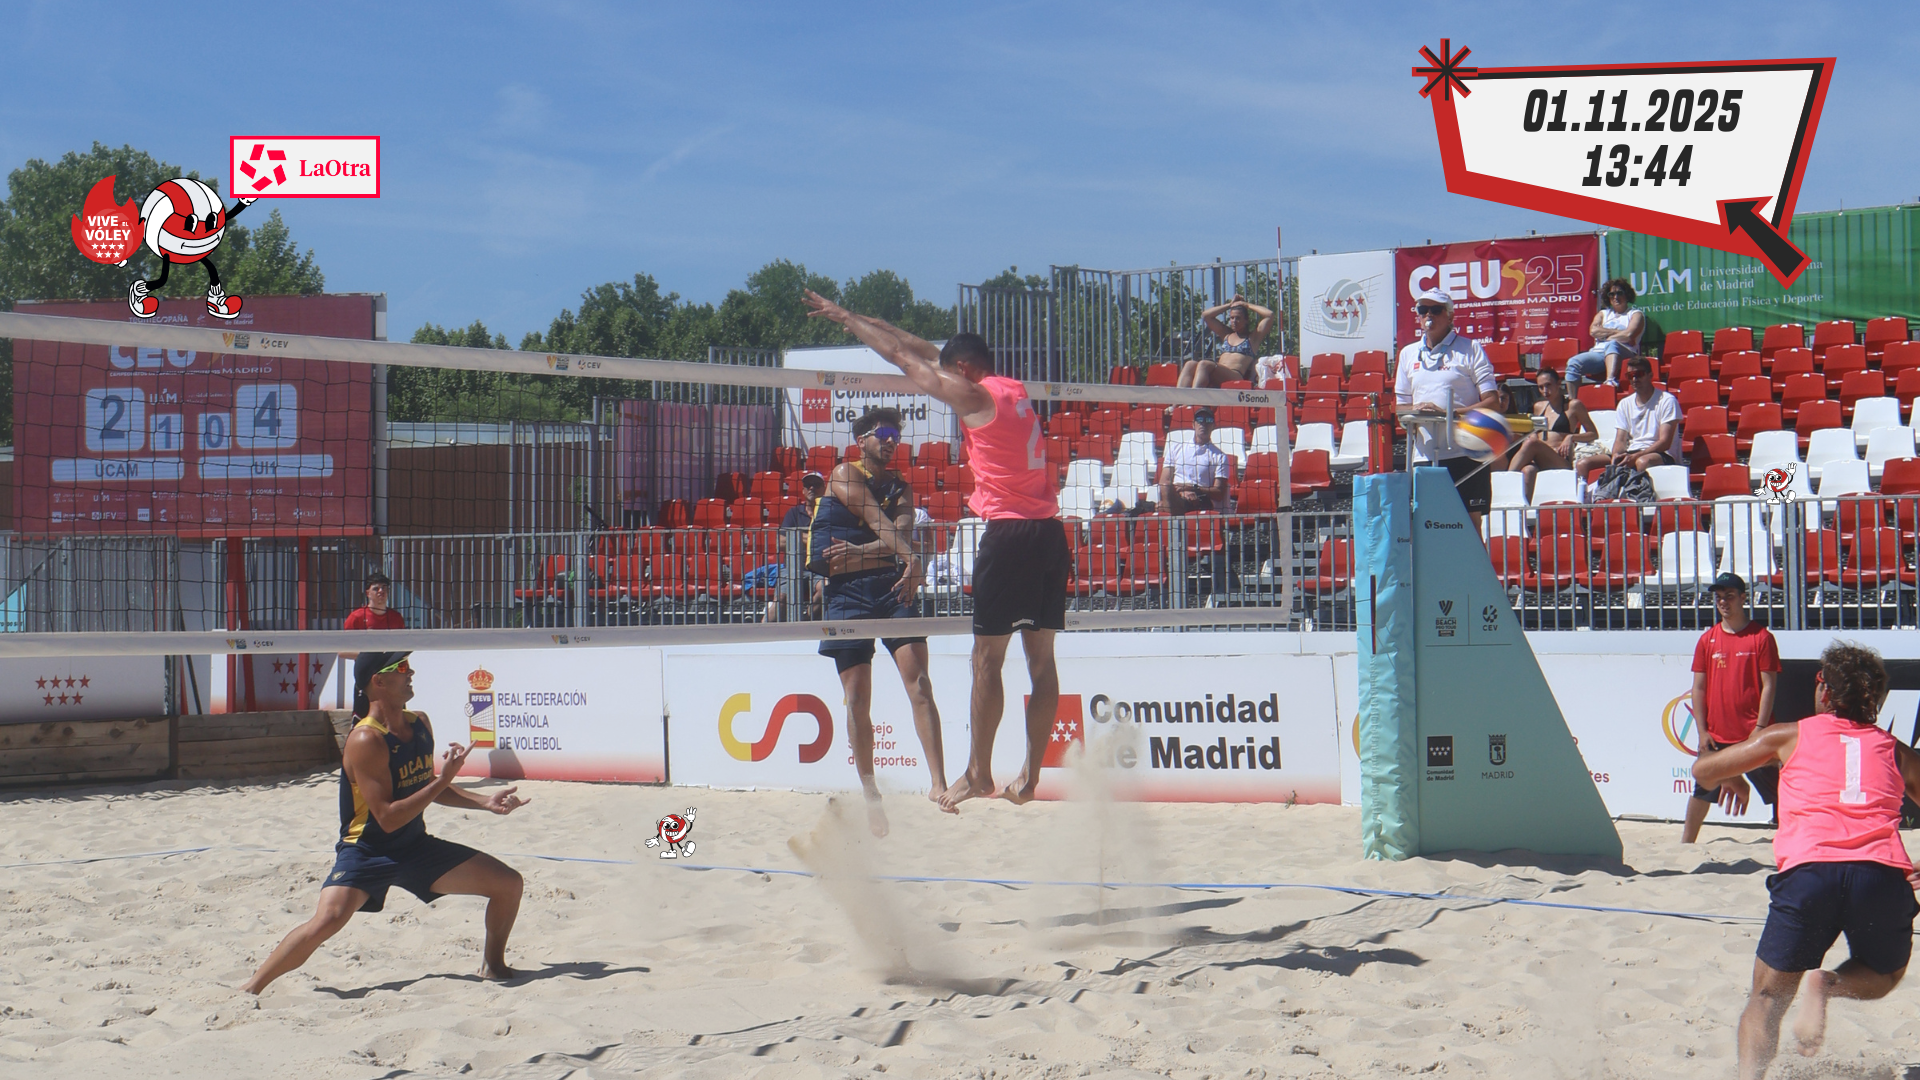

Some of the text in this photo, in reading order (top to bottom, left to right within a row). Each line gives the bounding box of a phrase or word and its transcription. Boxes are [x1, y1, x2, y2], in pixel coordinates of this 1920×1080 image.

[1700, 263, 1764, 277] Universidad
[1700, 278, 1754, 292] de Madrid
[1481, 298, 1526, 306] UNIVERSITARIOS
[1527, 295, 1582, 304] MADRID
[1672, 300, 1684, 310] de
[1687, 296, 1738, 310] Educación
[1742, 296, 1771, 307] Física
[1783, 293, 1824, 306] Deporte
[271, 340, 288, 348] CEV
[222, 366, 273, 375] MADRID
[586, 361, 601, 369] CEV
[1245, 393, 1269, 403] Senoh
[99, 394, 126, 440] 2
[254, 391, 282, 436] 4
[157, 416, 172, 449] 1
[206, 415, 225, 448] 0
[1016, 399, 1046, 470] 2
[95, 464, 139, 478] UCAM
[1433, 522, 1463, 530] Senoh
[471, 694, 492, 702] RFEVB
[498, 689, 587, 706] REAL FEDERACIÓN
[1089, 693, 1280, 724] Comunidad
[498, 712, 549, 728] ESPAÑOLA
[872, 721, 893, 737] sejo
[499, 736, 562, 750] DE VOLEIBOL
[1150, 736, 1282, 770] Madrid
[399, 753, 434, 781] UCAM
[873, 755, 918, 768] eportes
[1481, 770, 1515, 780] MADRID
[1839, 734, 1867, 804] 1
